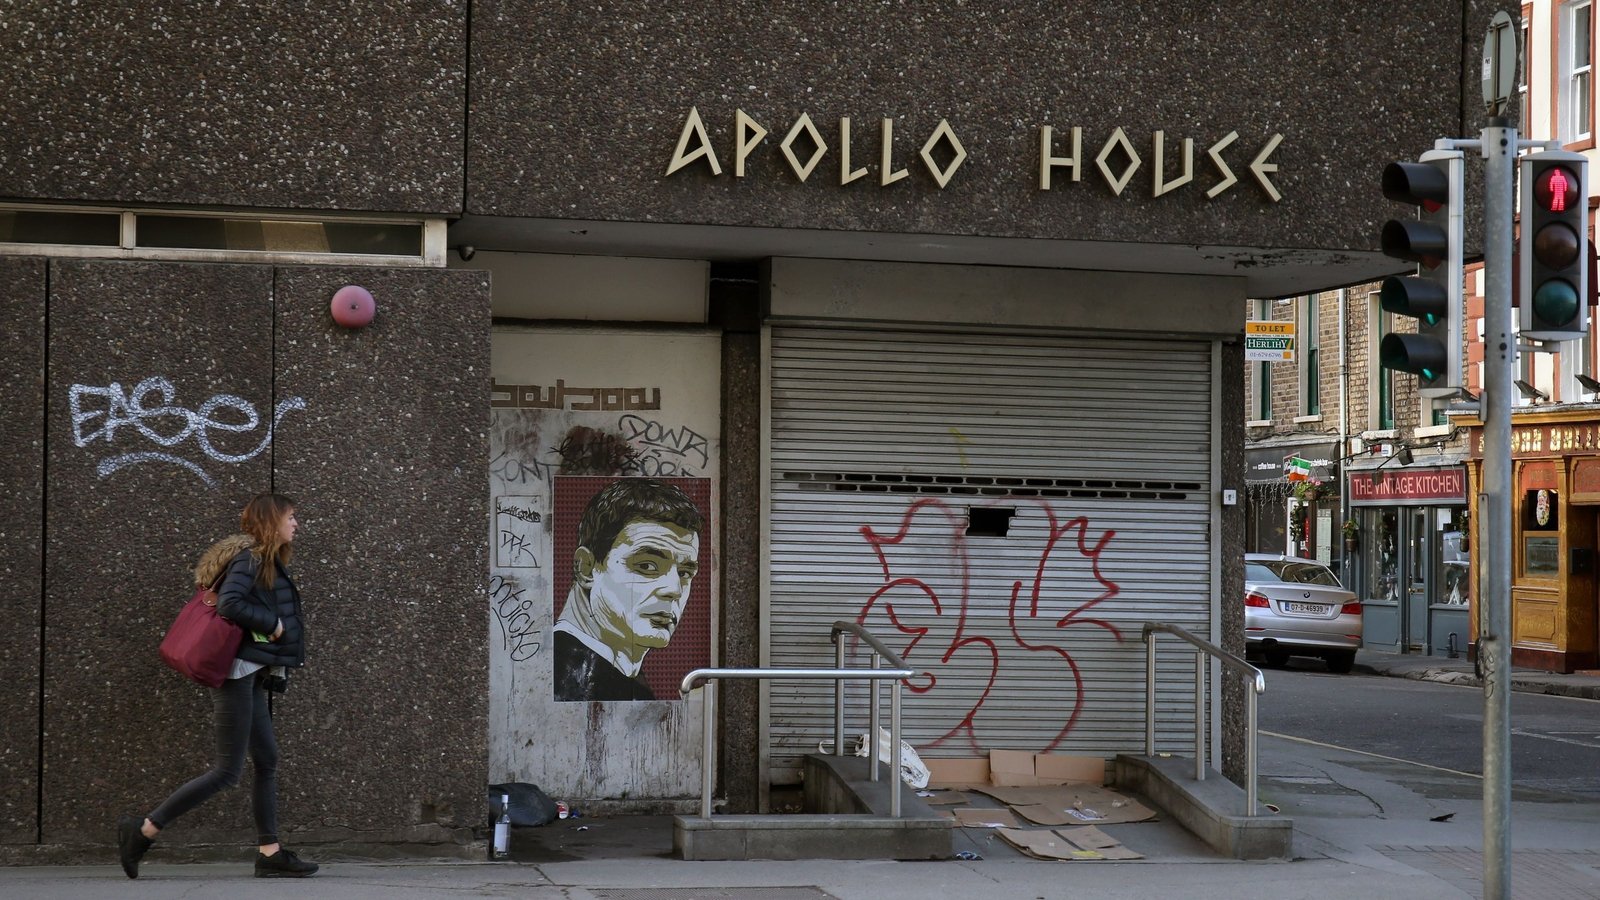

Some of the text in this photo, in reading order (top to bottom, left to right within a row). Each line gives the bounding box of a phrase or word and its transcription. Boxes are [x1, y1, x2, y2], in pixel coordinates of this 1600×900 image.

[665, 105, 1284, 201] APOLLO HOUSE
[1269, 325, 1286, 333] LET
[1247, 338, 1287, 349] HERLIHY
[1353, 474, 1460, 496] THE VINTAGE KITCHEN
